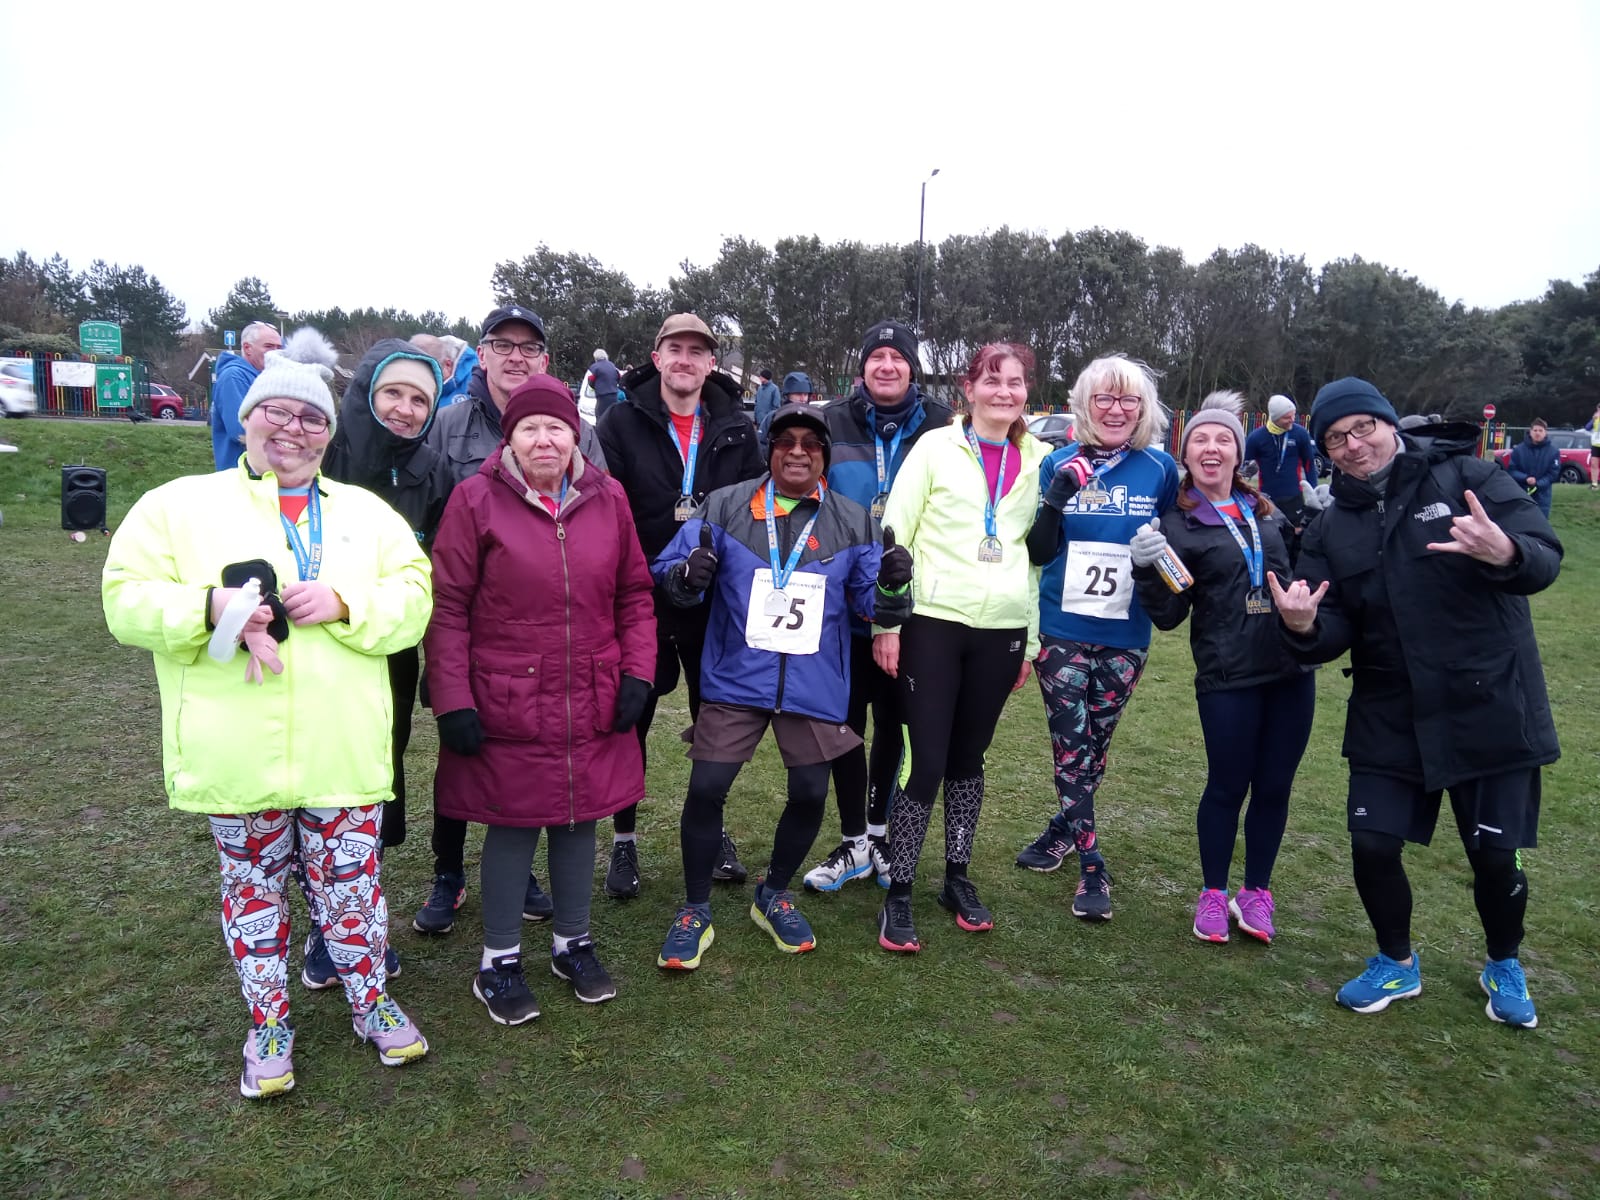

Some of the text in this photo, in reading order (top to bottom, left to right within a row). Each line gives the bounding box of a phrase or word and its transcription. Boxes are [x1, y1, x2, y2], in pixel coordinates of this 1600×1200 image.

[1422, 503, 1437, 511] THE
[1414, 507, 1439, 520] NORTH
[1422, 513, 1440, 522] FACE
[1084, 566, 1117, 596] 25
